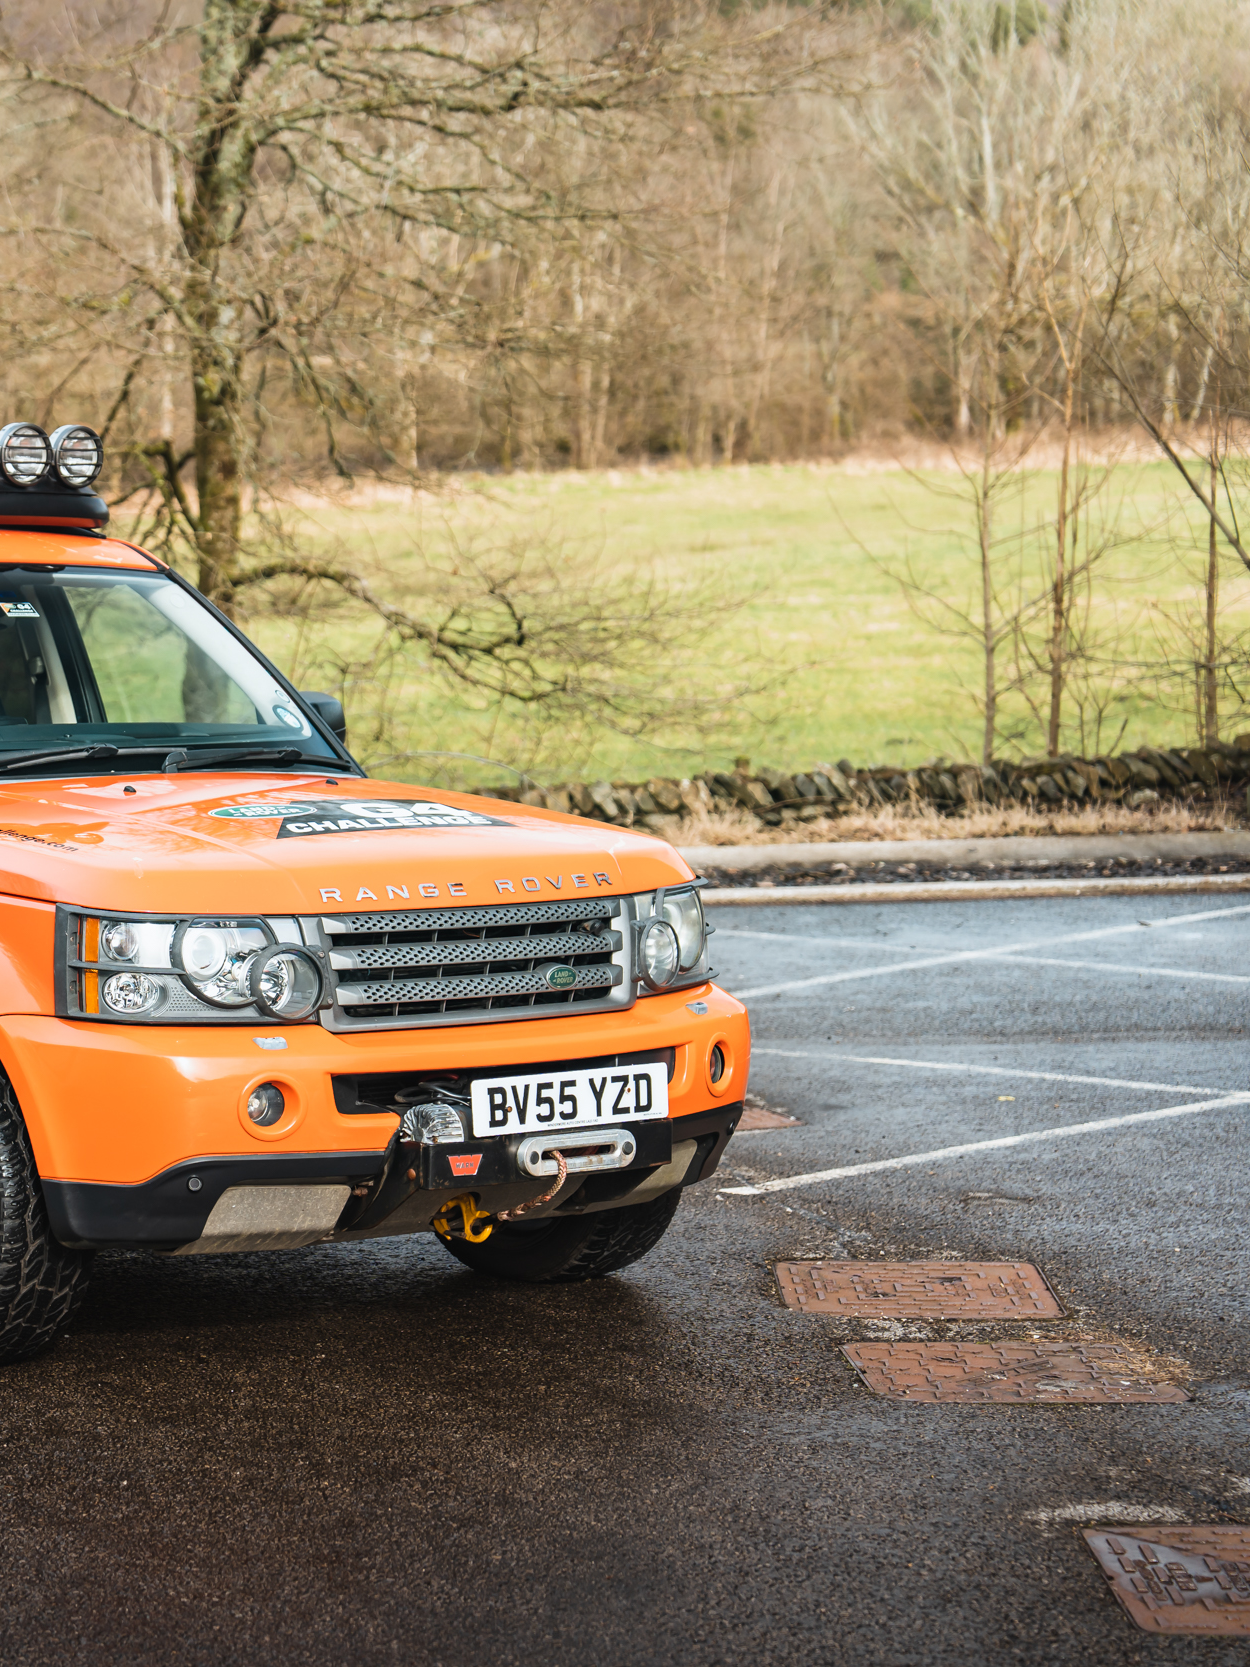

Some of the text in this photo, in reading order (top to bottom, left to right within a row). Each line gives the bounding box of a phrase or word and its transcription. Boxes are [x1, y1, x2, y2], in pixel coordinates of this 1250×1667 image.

[339, 802, 473, 819] G4
[285, 815, 493, 834] CHALLENGE
[319, 871, 613, 903] RANGE ROVER
[554, 970, 569, 978] LAND
[556, 976, 574, 984] ROVER
[487, 1072, 653, 1129] BV55 YZD
